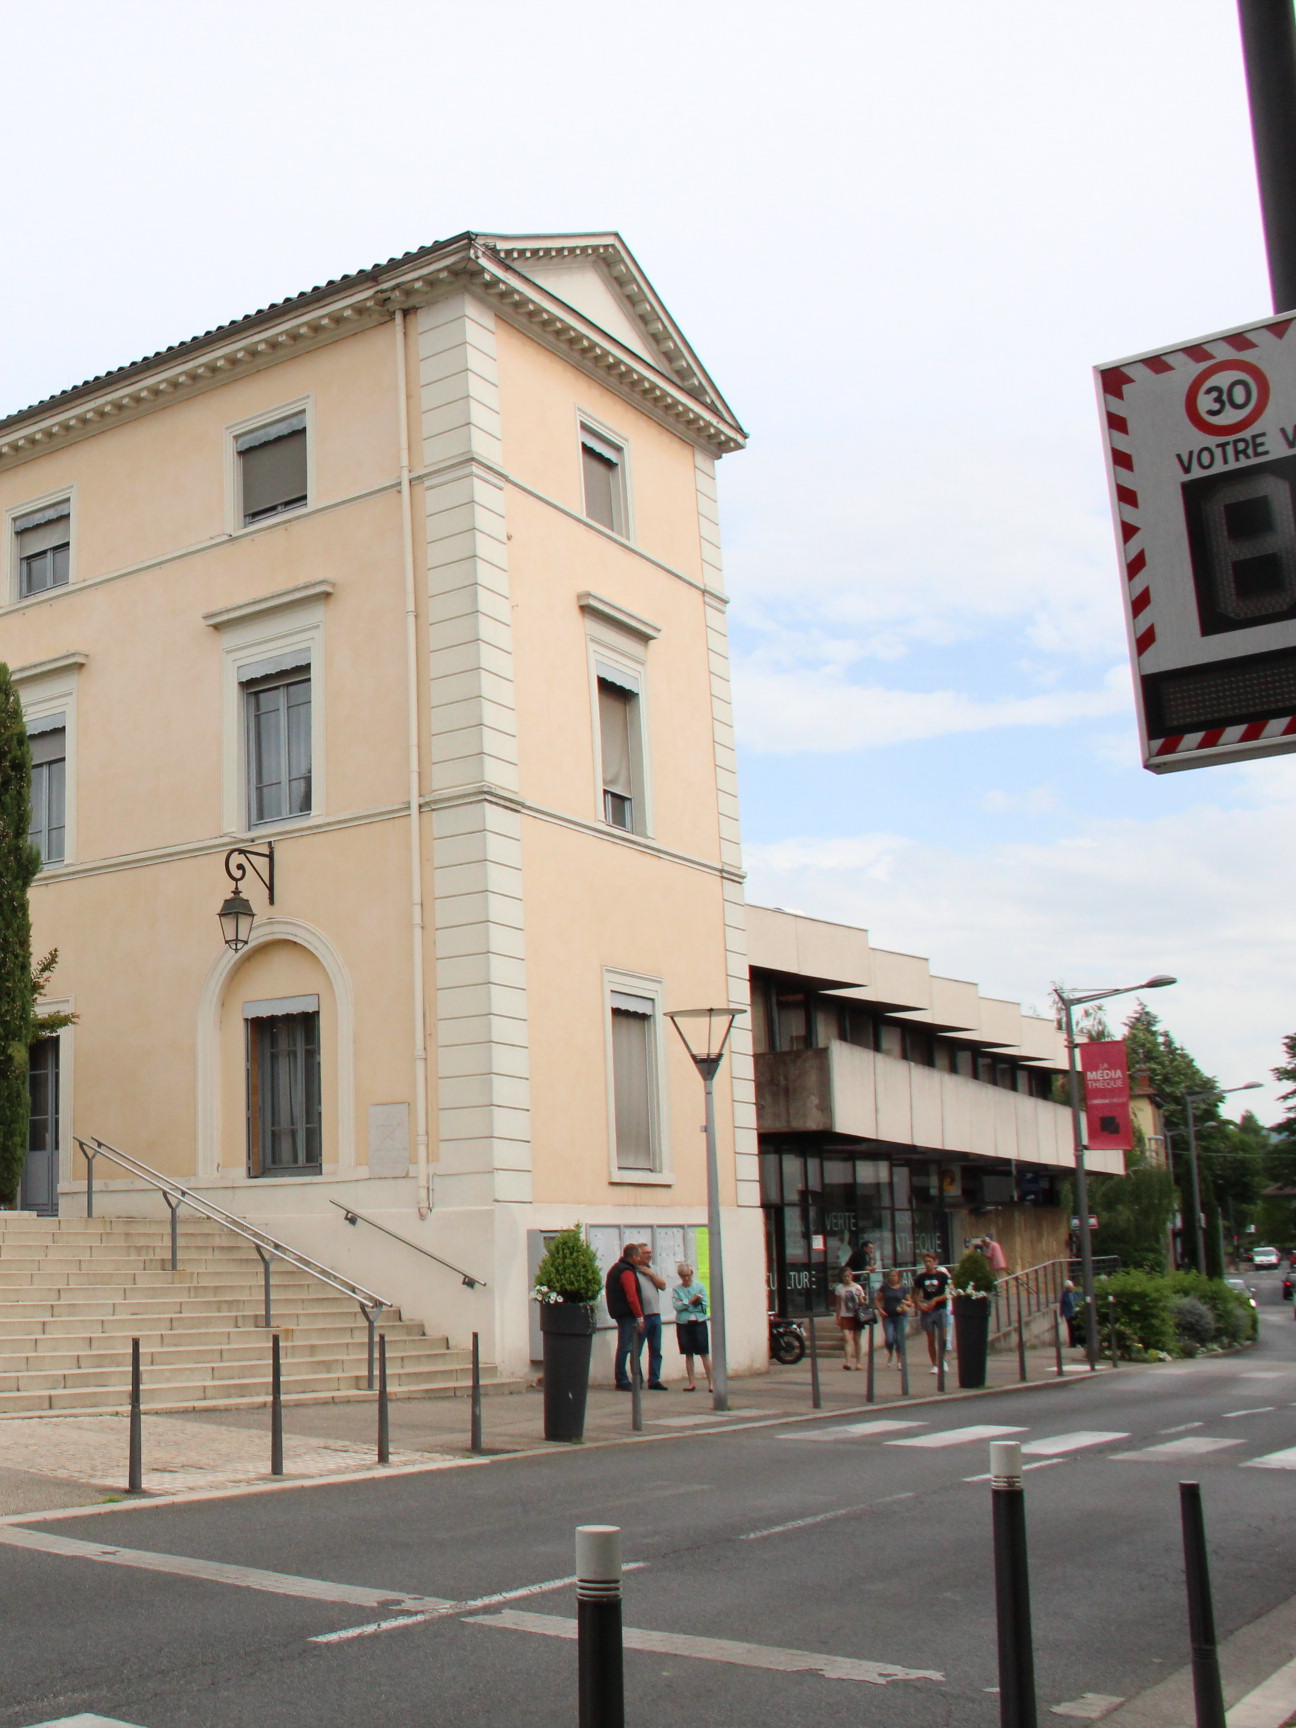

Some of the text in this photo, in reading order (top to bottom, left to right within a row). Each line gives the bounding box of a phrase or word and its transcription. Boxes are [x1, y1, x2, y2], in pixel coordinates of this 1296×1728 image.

[1203, 378, 1253, 417] 30
[1176, 431, 1270, 475] VOTRE
[1086, 1069, 1123, 1080] MÉDIA
